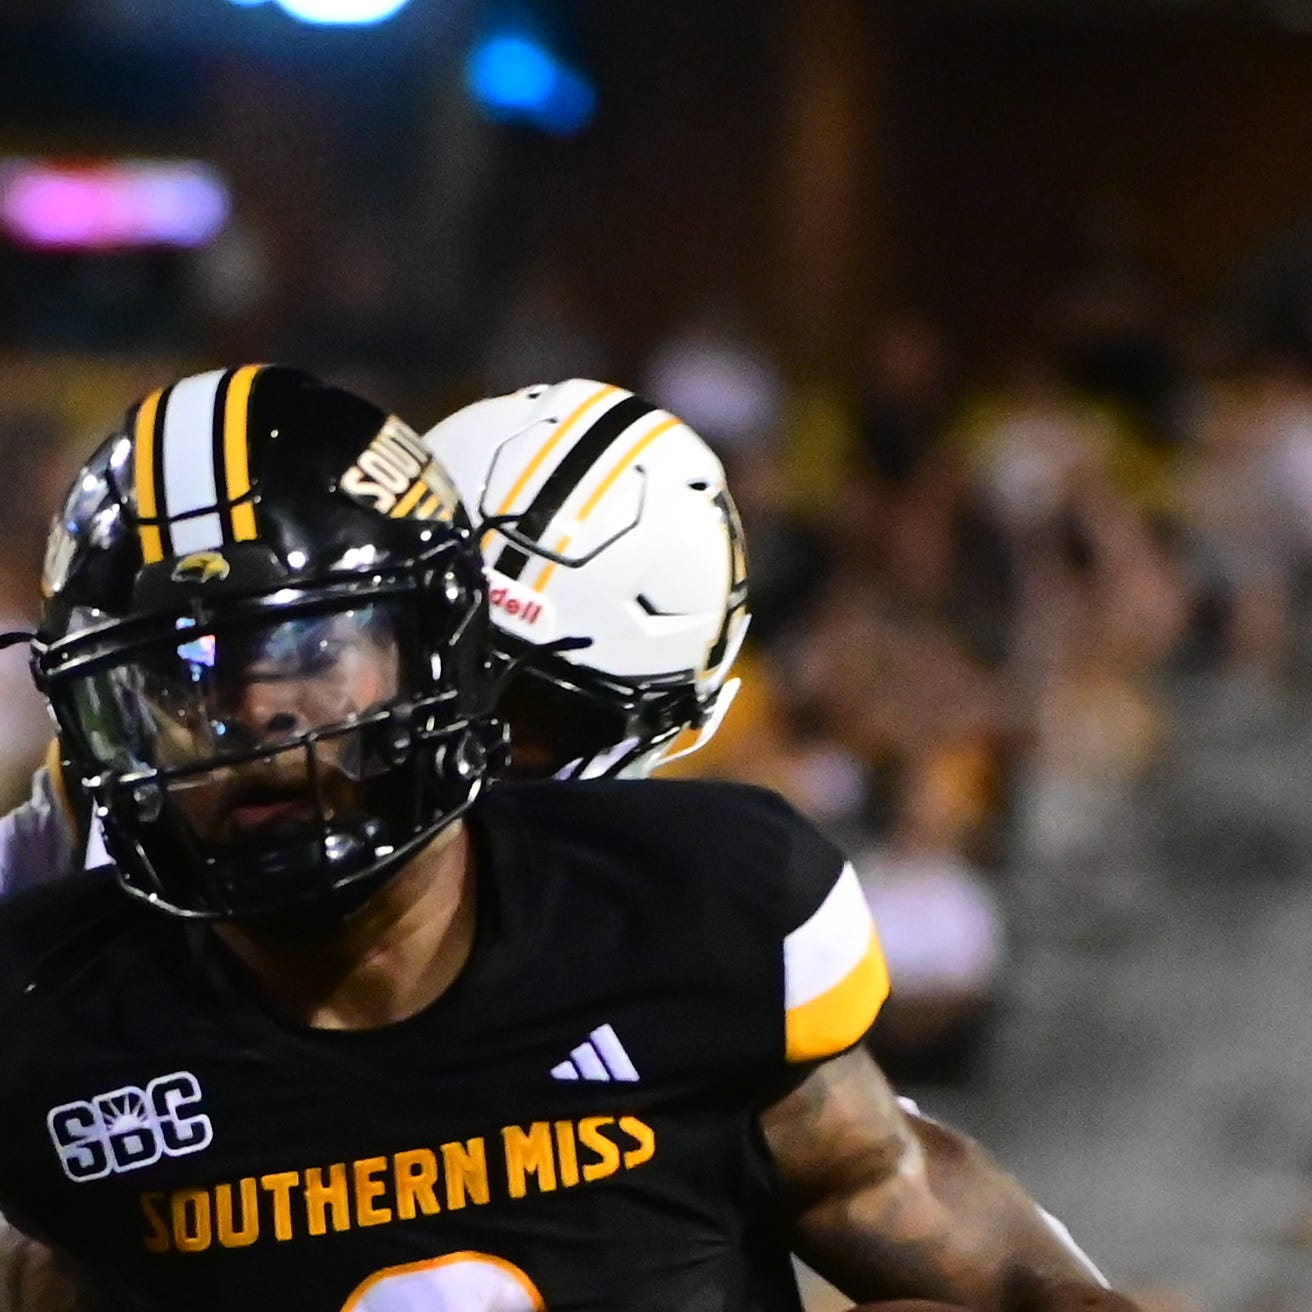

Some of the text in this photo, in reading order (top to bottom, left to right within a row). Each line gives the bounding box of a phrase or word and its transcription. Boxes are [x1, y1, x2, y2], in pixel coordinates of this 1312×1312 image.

[490, 587, 543, 626] dell
[46, 1070, 214, 1183] SBC
[140, 1115, 656, 1253] SOUTHERN MISS
